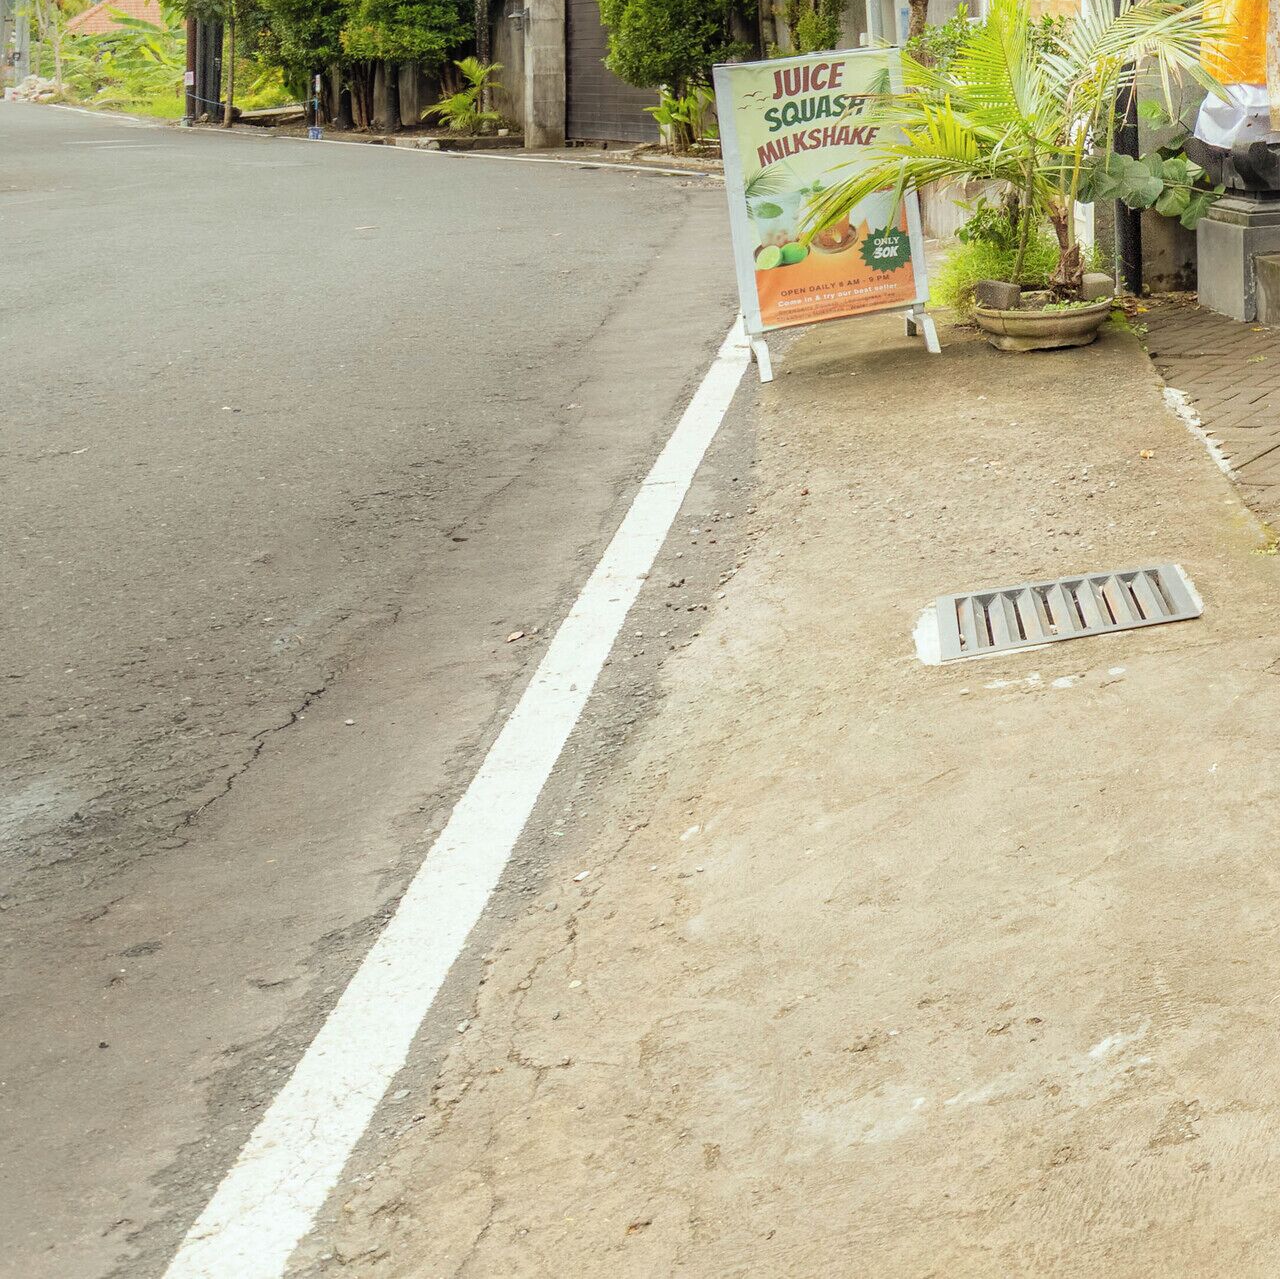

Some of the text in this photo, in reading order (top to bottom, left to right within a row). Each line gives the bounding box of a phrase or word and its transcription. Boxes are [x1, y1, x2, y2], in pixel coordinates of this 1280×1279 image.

[773, 62, 845, 99] JUICE
[764, 94, 866, 132] SQUASH
[757, 125, 880, 168] MILKSHAKE
[873, 236, 900, 246] ONLY
[781, 286, 806, 297] OPEN
[809, 282, 836, 292] DAILY
[847, 278, 860, 286] AM
